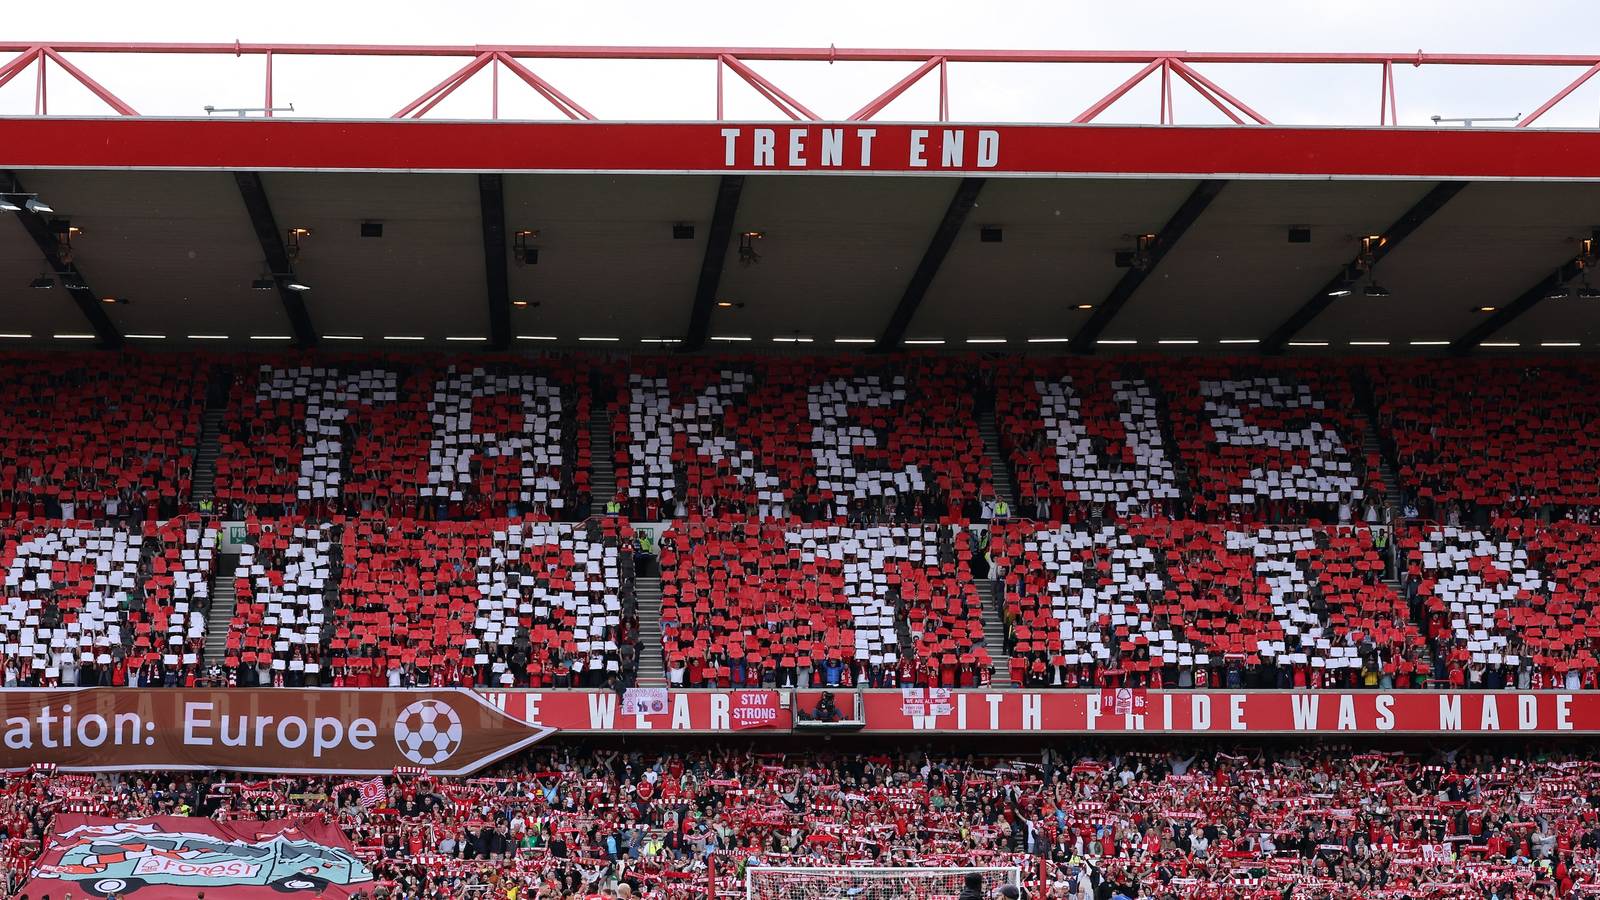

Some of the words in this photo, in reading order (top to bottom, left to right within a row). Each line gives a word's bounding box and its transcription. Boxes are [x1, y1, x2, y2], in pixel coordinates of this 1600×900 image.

[721, 128, 877, 166] TRENT
[909, 129, 1000, 168] END
[256, 366, 926, 508] TAKE
[1034, 376, 1364, 505] US
[733, 708, 776, 719] STRONG
[741, 694, 768, 705] STAY
[1291, 695, 1396, 731] WAS
[1439, 695, 1575, 731] MADE
[4, 704, 155, 749] ation:
[184, 702, 377, 757] Europe
